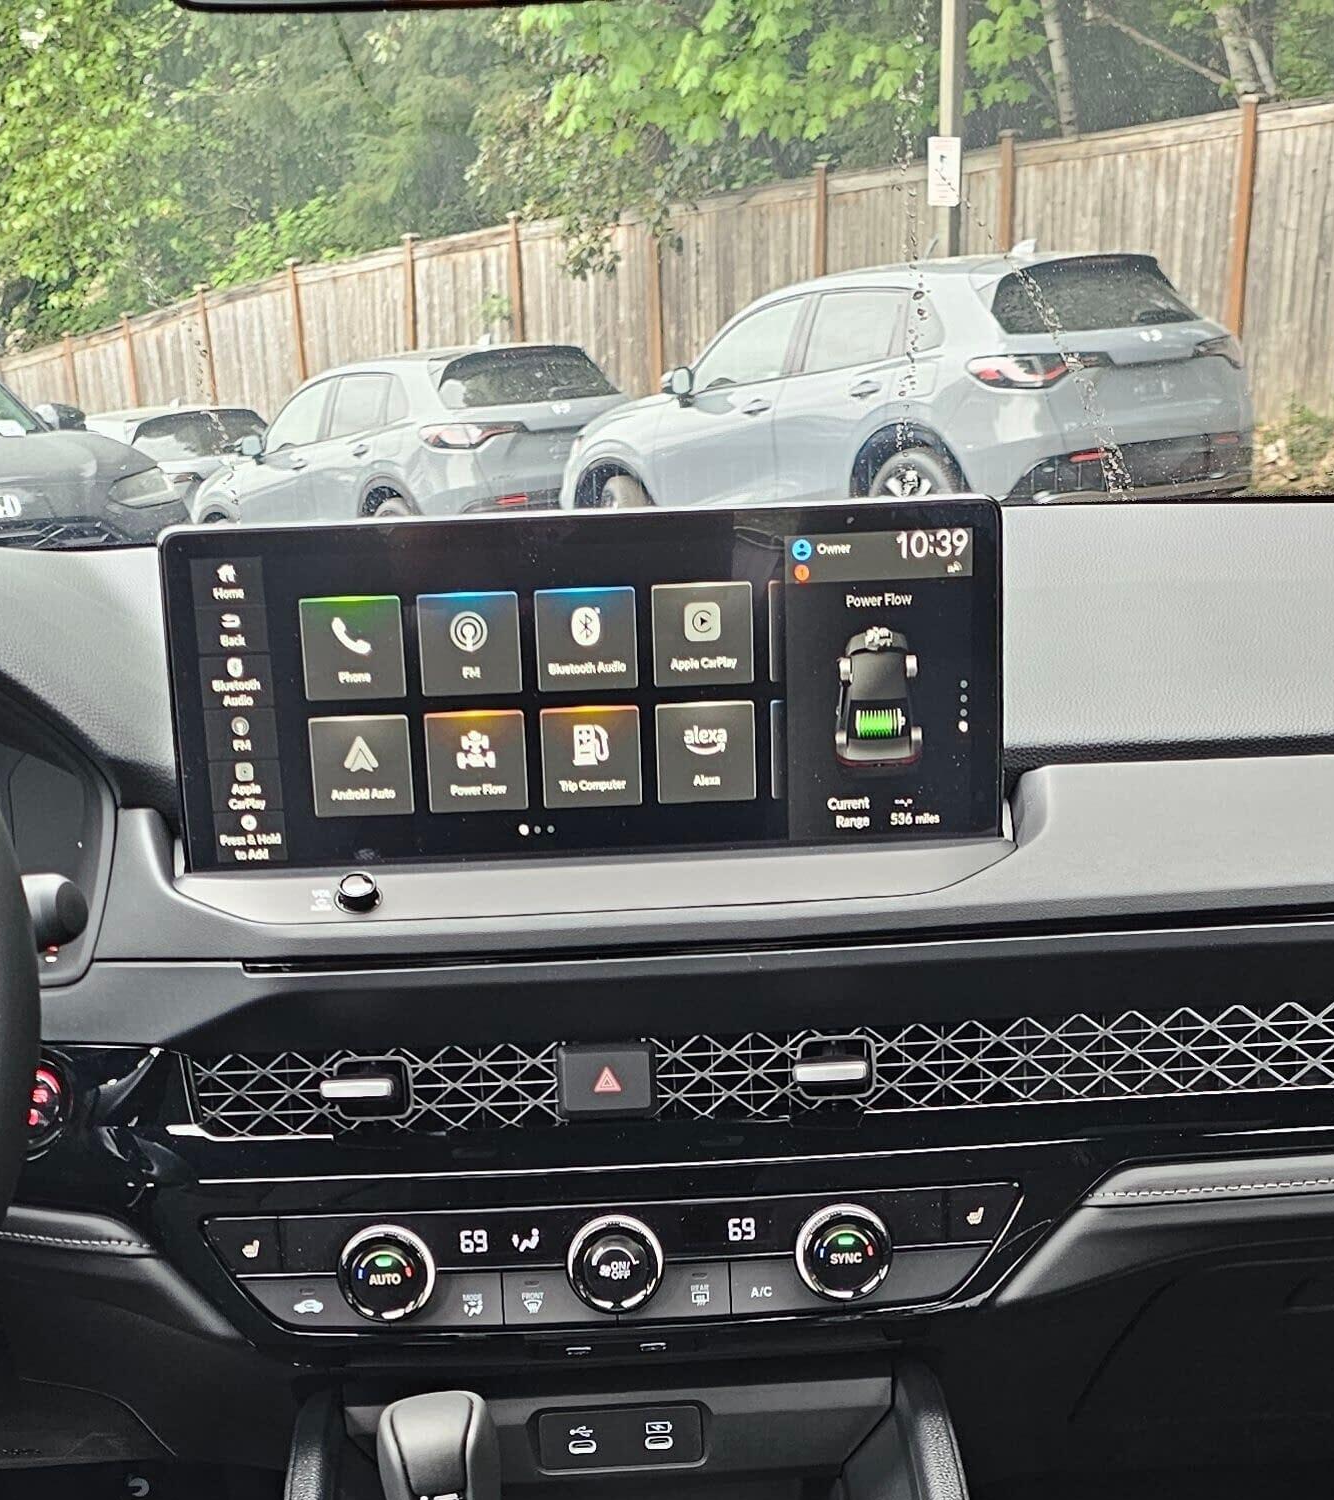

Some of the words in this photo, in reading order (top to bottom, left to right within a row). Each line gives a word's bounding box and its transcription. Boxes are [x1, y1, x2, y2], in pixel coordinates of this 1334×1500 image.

[817, 543, 851, 555] Owner
[896, 528, 969, 559] 10:39
[212, 587, 244, 600] Home
[845, 594, 882, 608] Power
[884, 592, 913, 606] Flow
[548, 660, 596, 676] Bluetooth
[597, 659, 627, 674] Audio
[670, 657, 699, 672] Apple
[700, 656, 738, 670] CarPlay
[337, 671, 371, 684] Phone
[462, 666, 481, 679] FM
[211, 679, 261, 692] Bluetooth
[223, 695, 254, 707] Audio
[683, 725, 728, 744] alexa
[232, 739, 252, 752] FM
[559, 779, 578, 793] Trip
[578, 778, 627, 792] Computer
[693, 774, 721, 787] Alexa
[231, 784, 262, 796] Apple
[330, 788, 370, 801] Android
[370, 787, 396, 800] Auto
[450, 784, 481, 797] Power
[482, 783, 507, 795] Flow
[827, 796, 870, 811] Current
[835, 815, 870, 829] Range
[890, 812, 913, 826] 536
[914, 813, 940, 825] miles
[727, 1217, 756, 1241] 69
[459, 1229, 489, 1253] 69
[829, 1252, 863, 1265] SYNC
[369, 1272, 401, 1286] AUTO
[611, 1270, 631, 1281] OFF
[462, 1293, 483, 1302] MODE
[521, 1291, 544, 1300] FRONT
[750, 1286, 773, 1298] A/C
